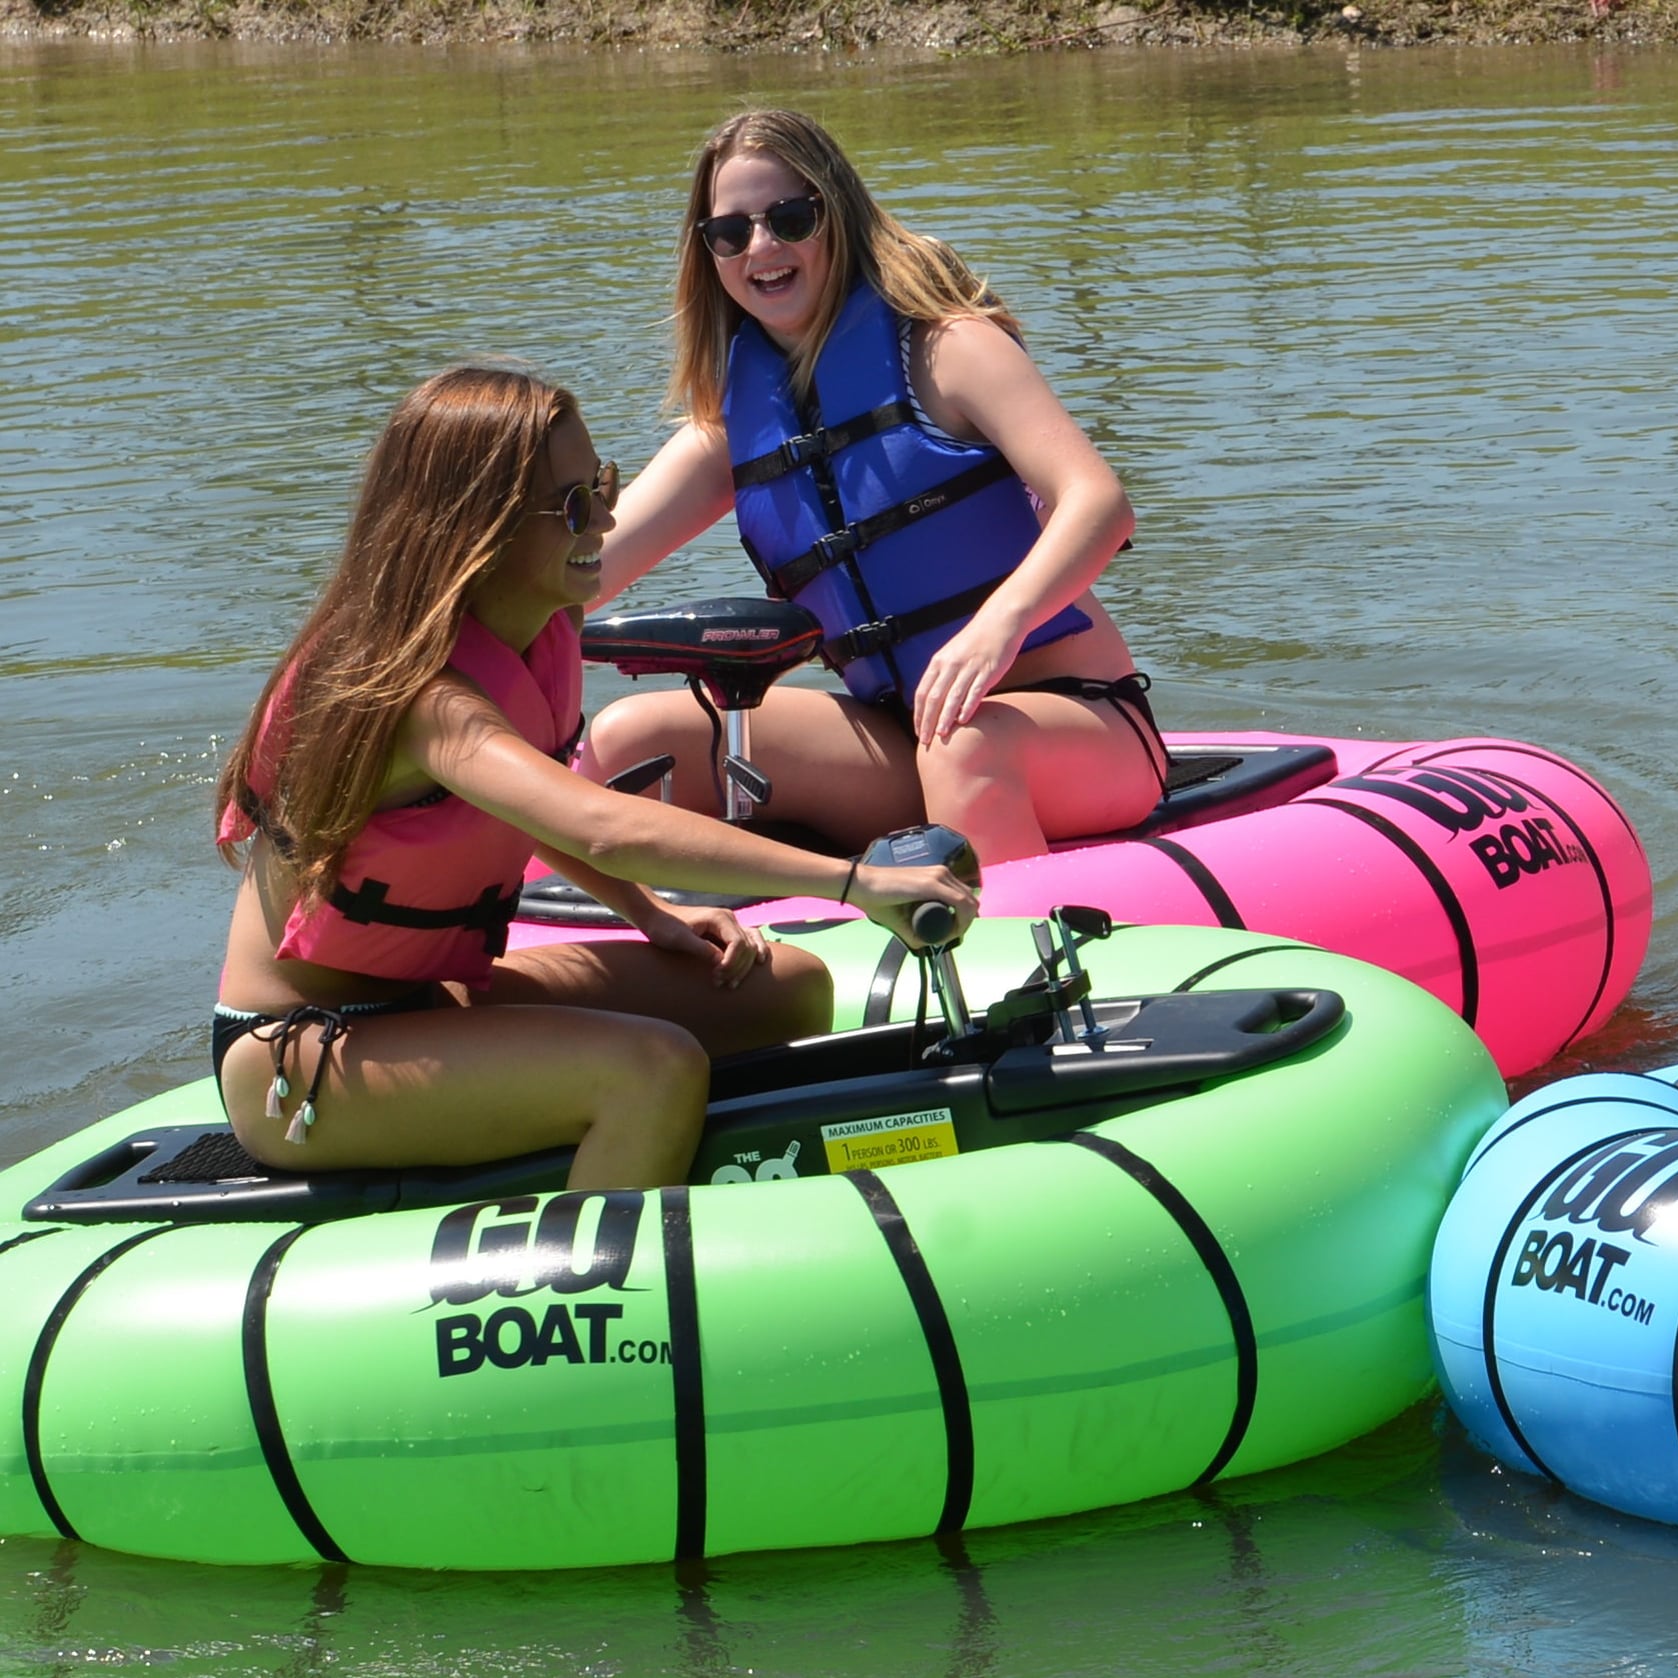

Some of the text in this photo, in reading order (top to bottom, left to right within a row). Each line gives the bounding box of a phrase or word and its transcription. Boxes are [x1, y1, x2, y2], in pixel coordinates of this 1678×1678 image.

[702, 628, 780, 642] PROWLER
[828, 1110, 946, 1138] MAXIMUM CAPACITIES
[733, 1150, 761, 1164] THE
[841, 1143, 852, 1161] 1
[852, 1146, 884, 1160] PERSON
[884, 1143, 897, 1155] OR
[897, 1136, 921, 1153] 300
